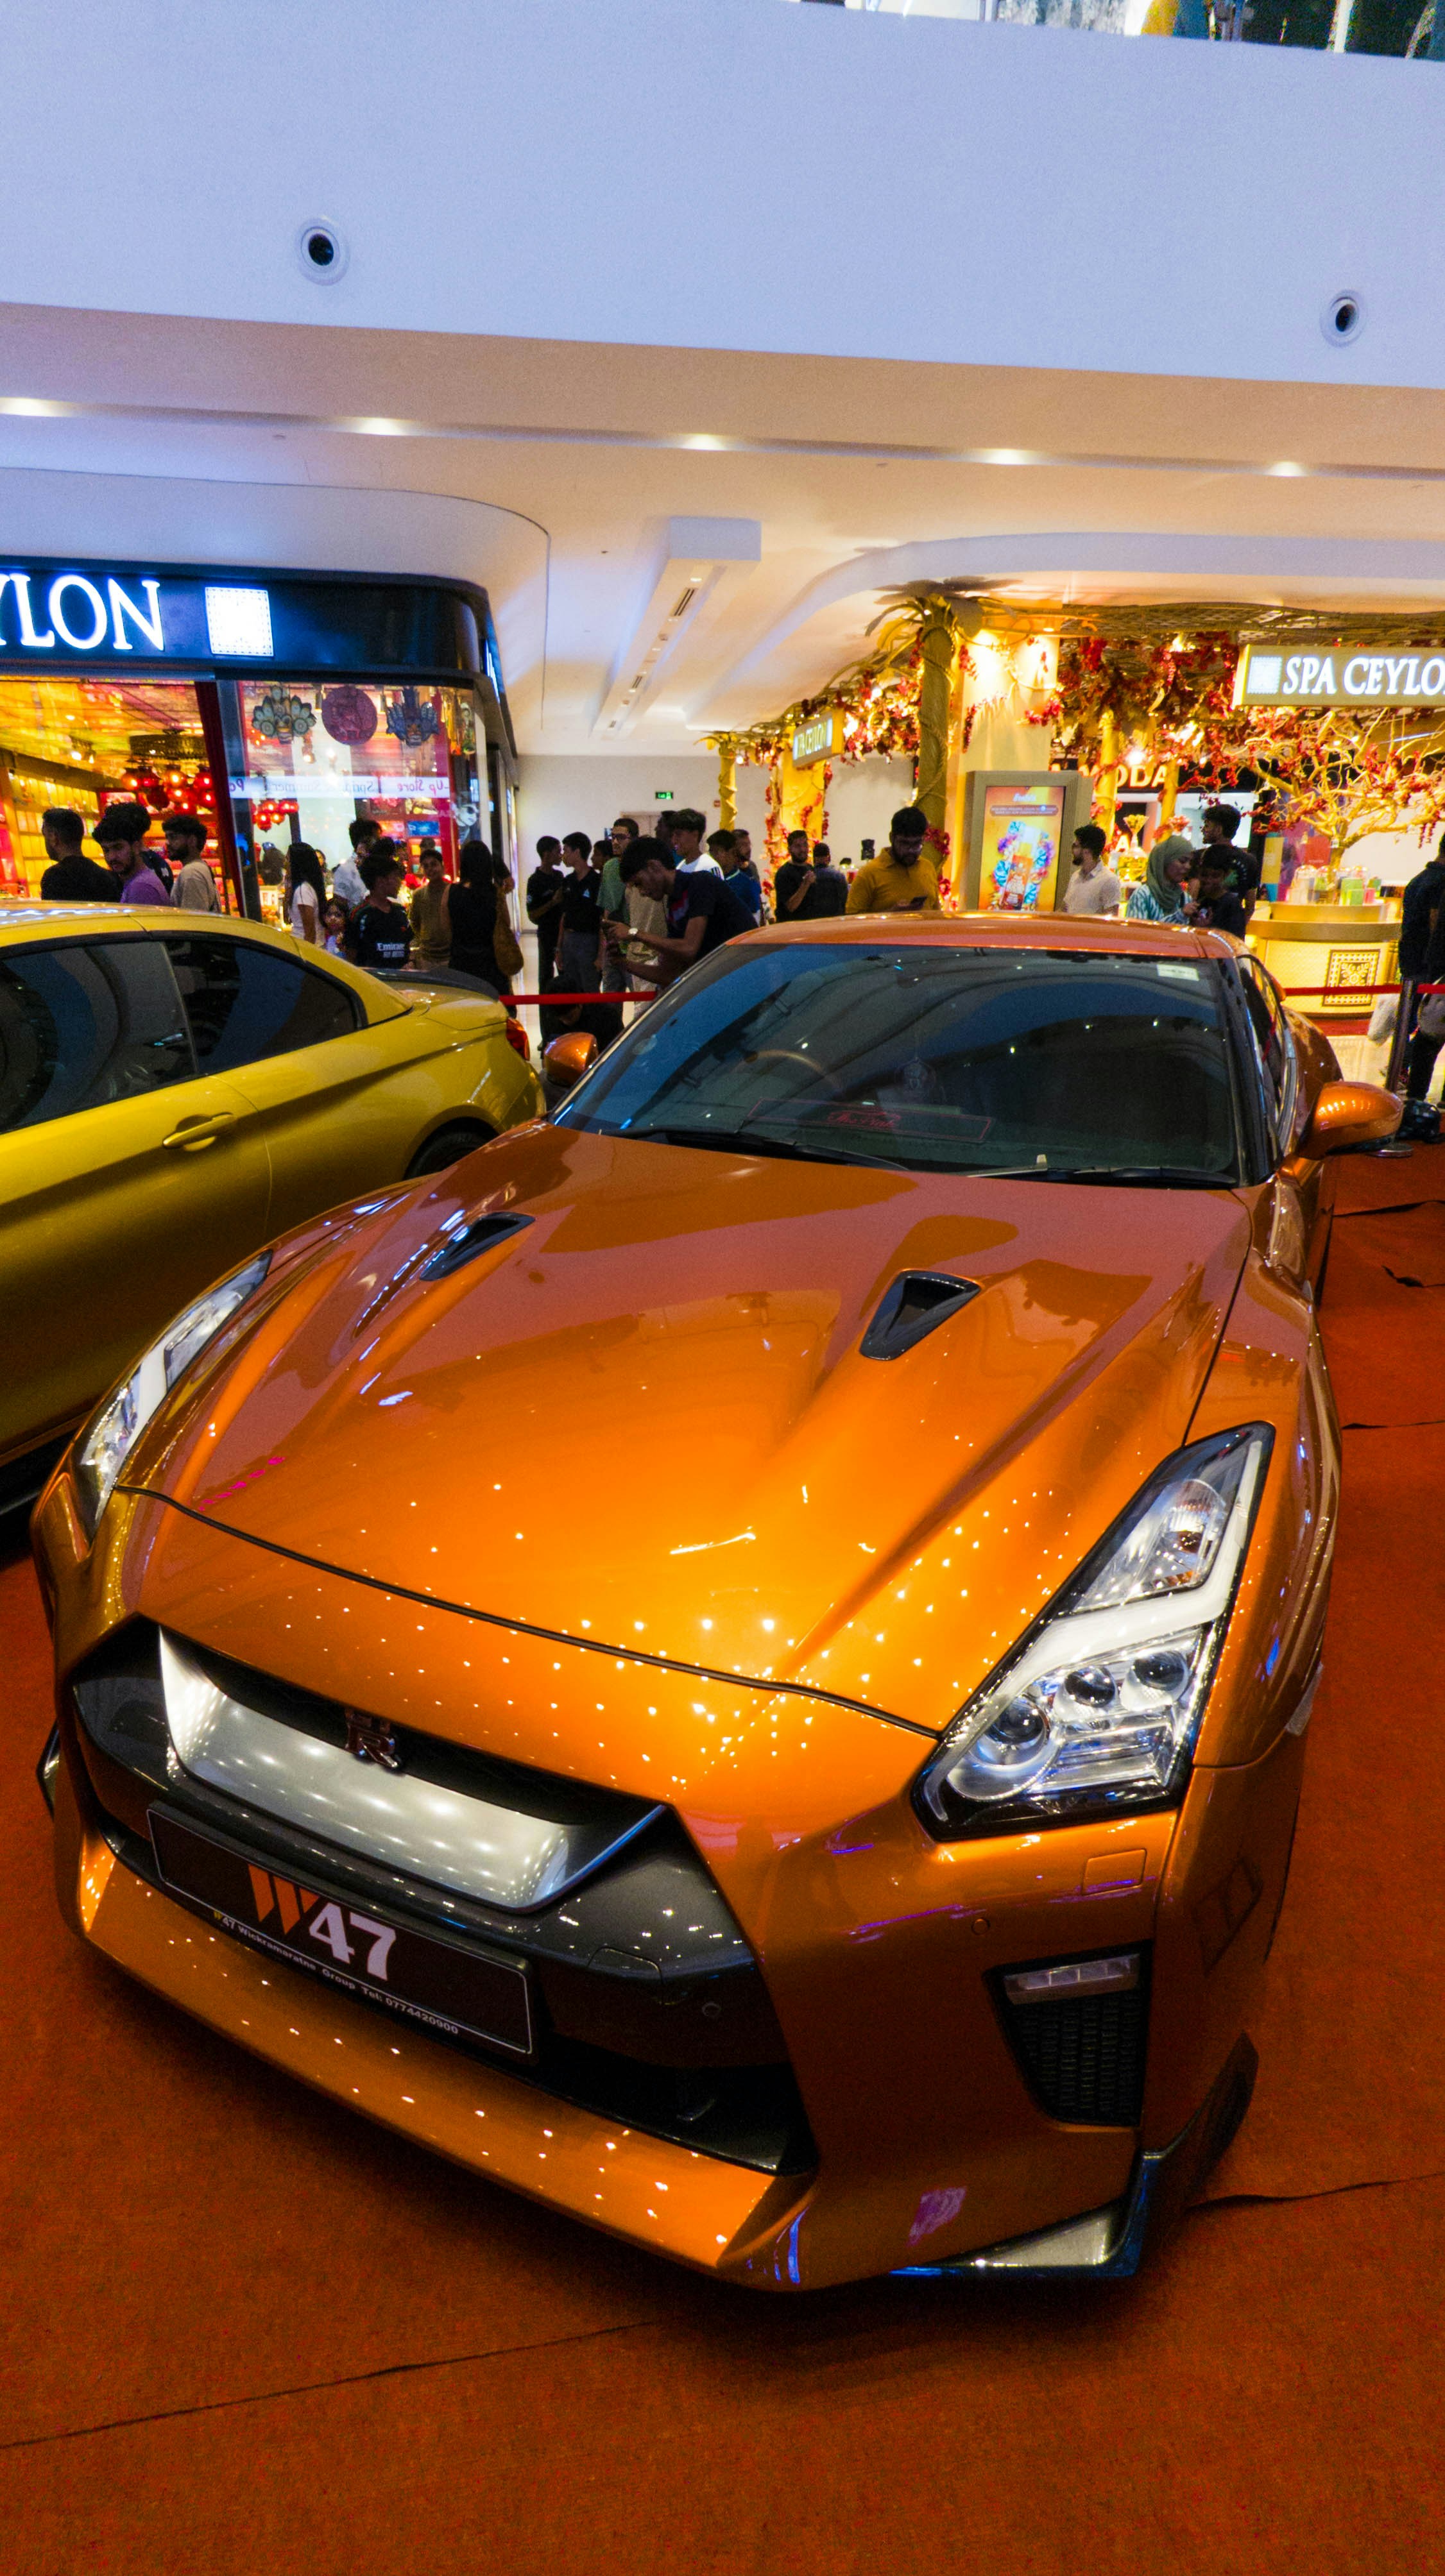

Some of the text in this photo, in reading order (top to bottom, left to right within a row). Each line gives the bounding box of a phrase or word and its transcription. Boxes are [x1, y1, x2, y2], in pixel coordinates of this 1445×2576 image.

[0, 573, 164, 651] LON
[1283, 656, 1445, 696] SPA CEYLO
[322, 1968, 355, 1990] Group
[386, 1997, 459, 2035] 0774420900
